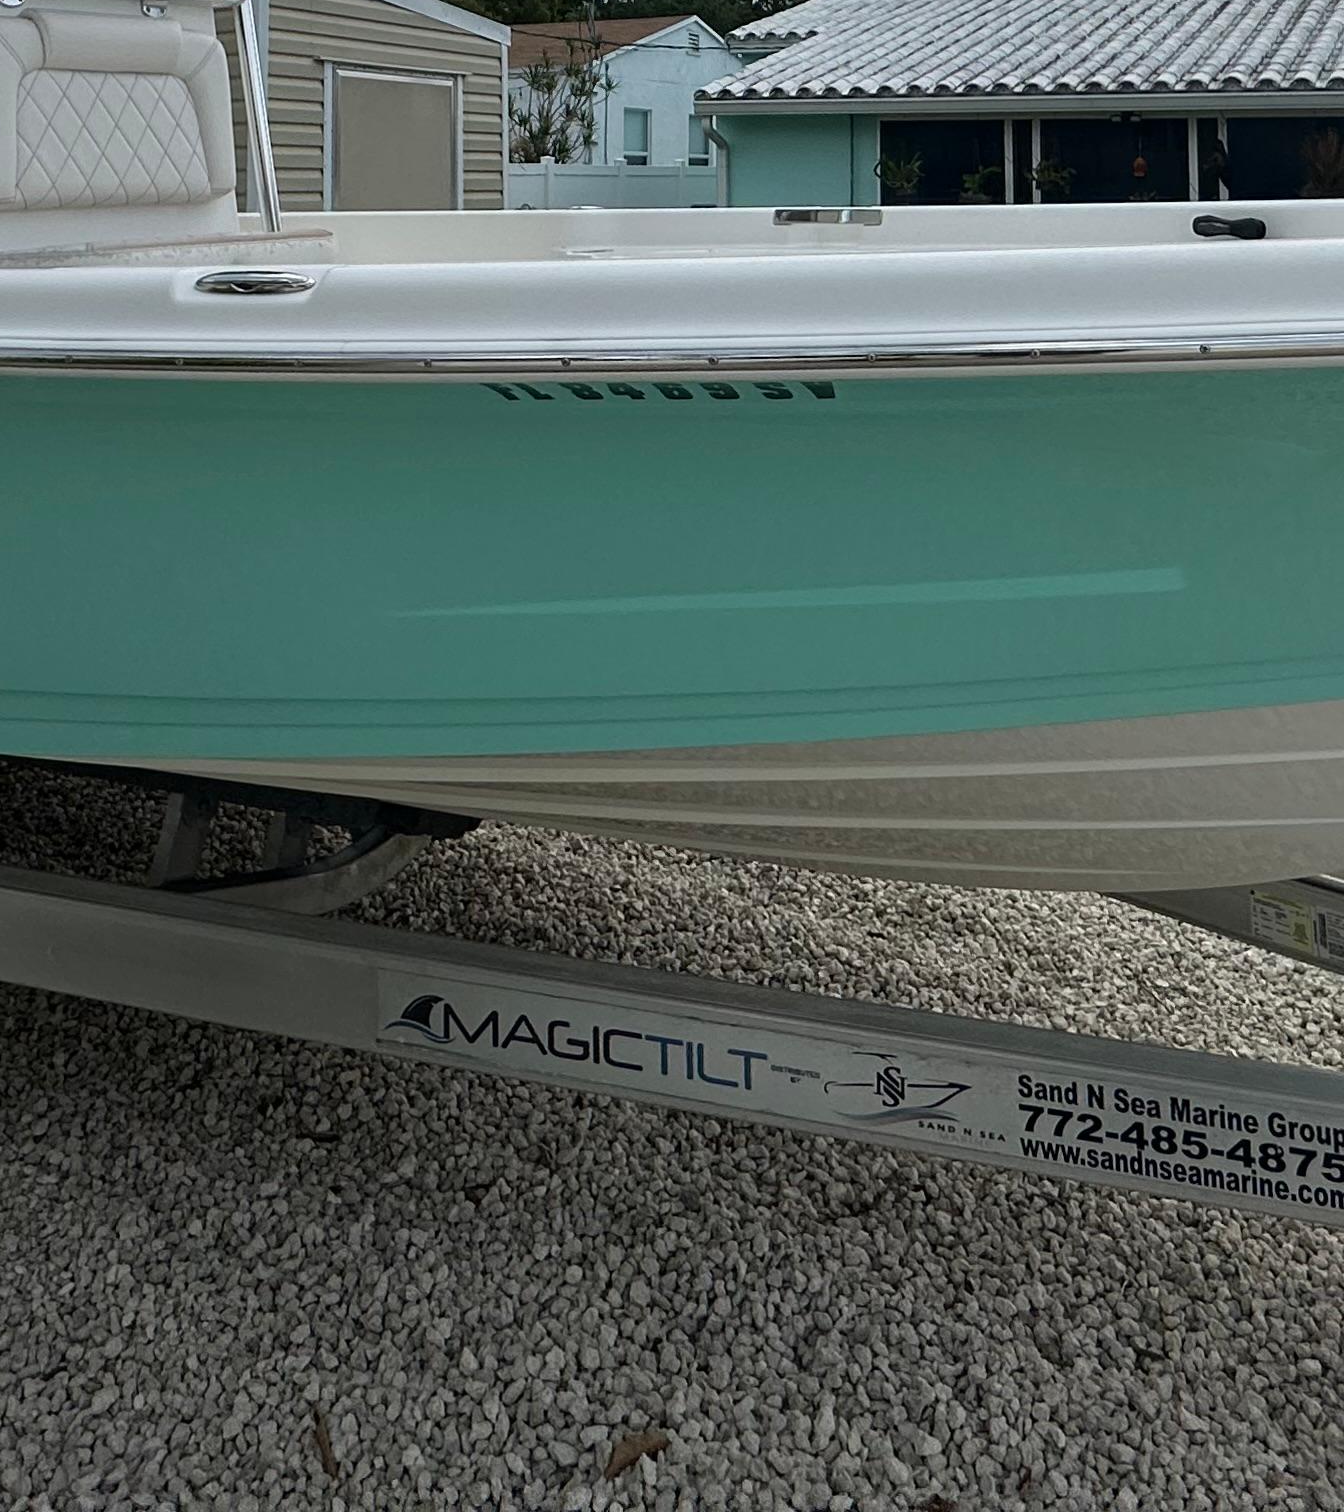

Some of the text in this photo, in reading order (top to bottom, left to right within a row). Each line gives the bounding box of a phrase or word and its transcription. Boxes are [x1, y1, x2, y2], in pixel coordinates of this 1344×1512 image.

[444, 1002, 767, 1091] MAGICTILT
[918, 1120, 956, 1133] SAND
[963, 1128, 972, 1136] N
[980, 1131, 1006, 1142] SEA
[1018, 1074, 1079, 1106] Sand
[1087, 1084, 1105, 1110] N
[1114, 1088, 1161, 1119] Sea
[1170, 1096, 1259, 1134] Marine
